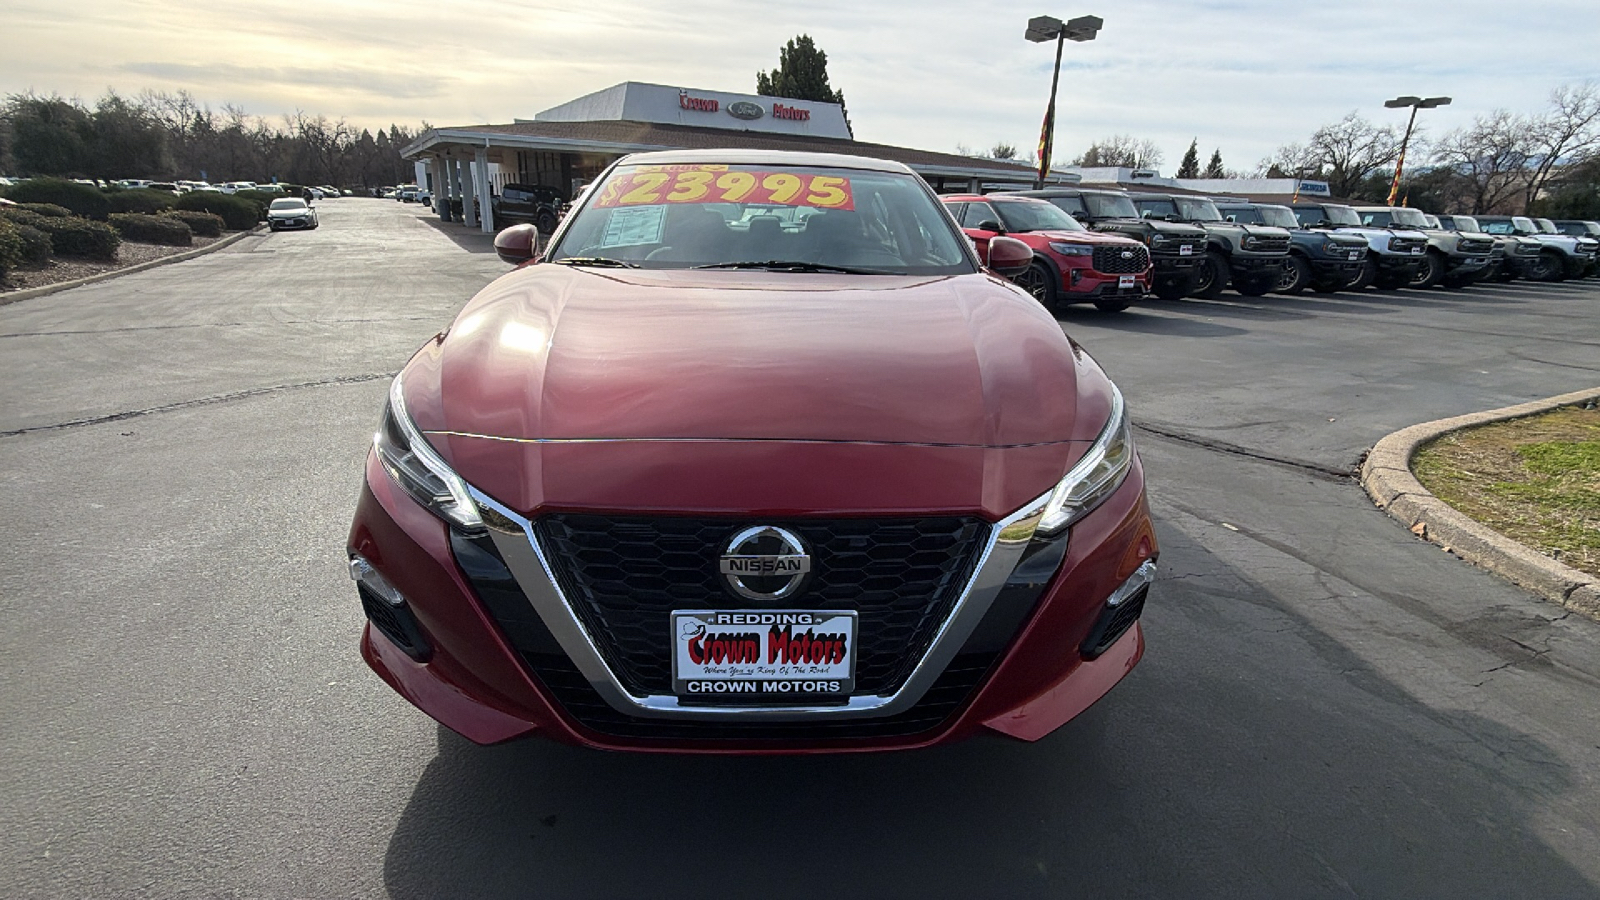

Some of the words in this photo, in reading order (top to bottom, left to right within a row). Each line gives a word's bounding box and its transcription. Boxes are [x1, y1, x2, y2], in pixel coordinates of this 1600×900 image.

[680, 94, 719, 112] Crown
[737, 104, 757, 116] Ford
[773, 102, 810, 120] Motors
[600, 171, 849, 206] $23995
[730, 559, 801, 571] NISSAN
[717, 614, 813, 624] REDDING
[688, 628, 760, 665] Crown
[768, 625, 847, 665] Motors
[703, 666, 727, 674] Where
[757, 666, 776, 675] King
[779, 666, 789, 675] Of
[792, 666, 806, 674] The
[808, 666, 830, 674] Road
[687, 681, 756, 692] CROWN
[762, 681, 840, 692] MOTORS
